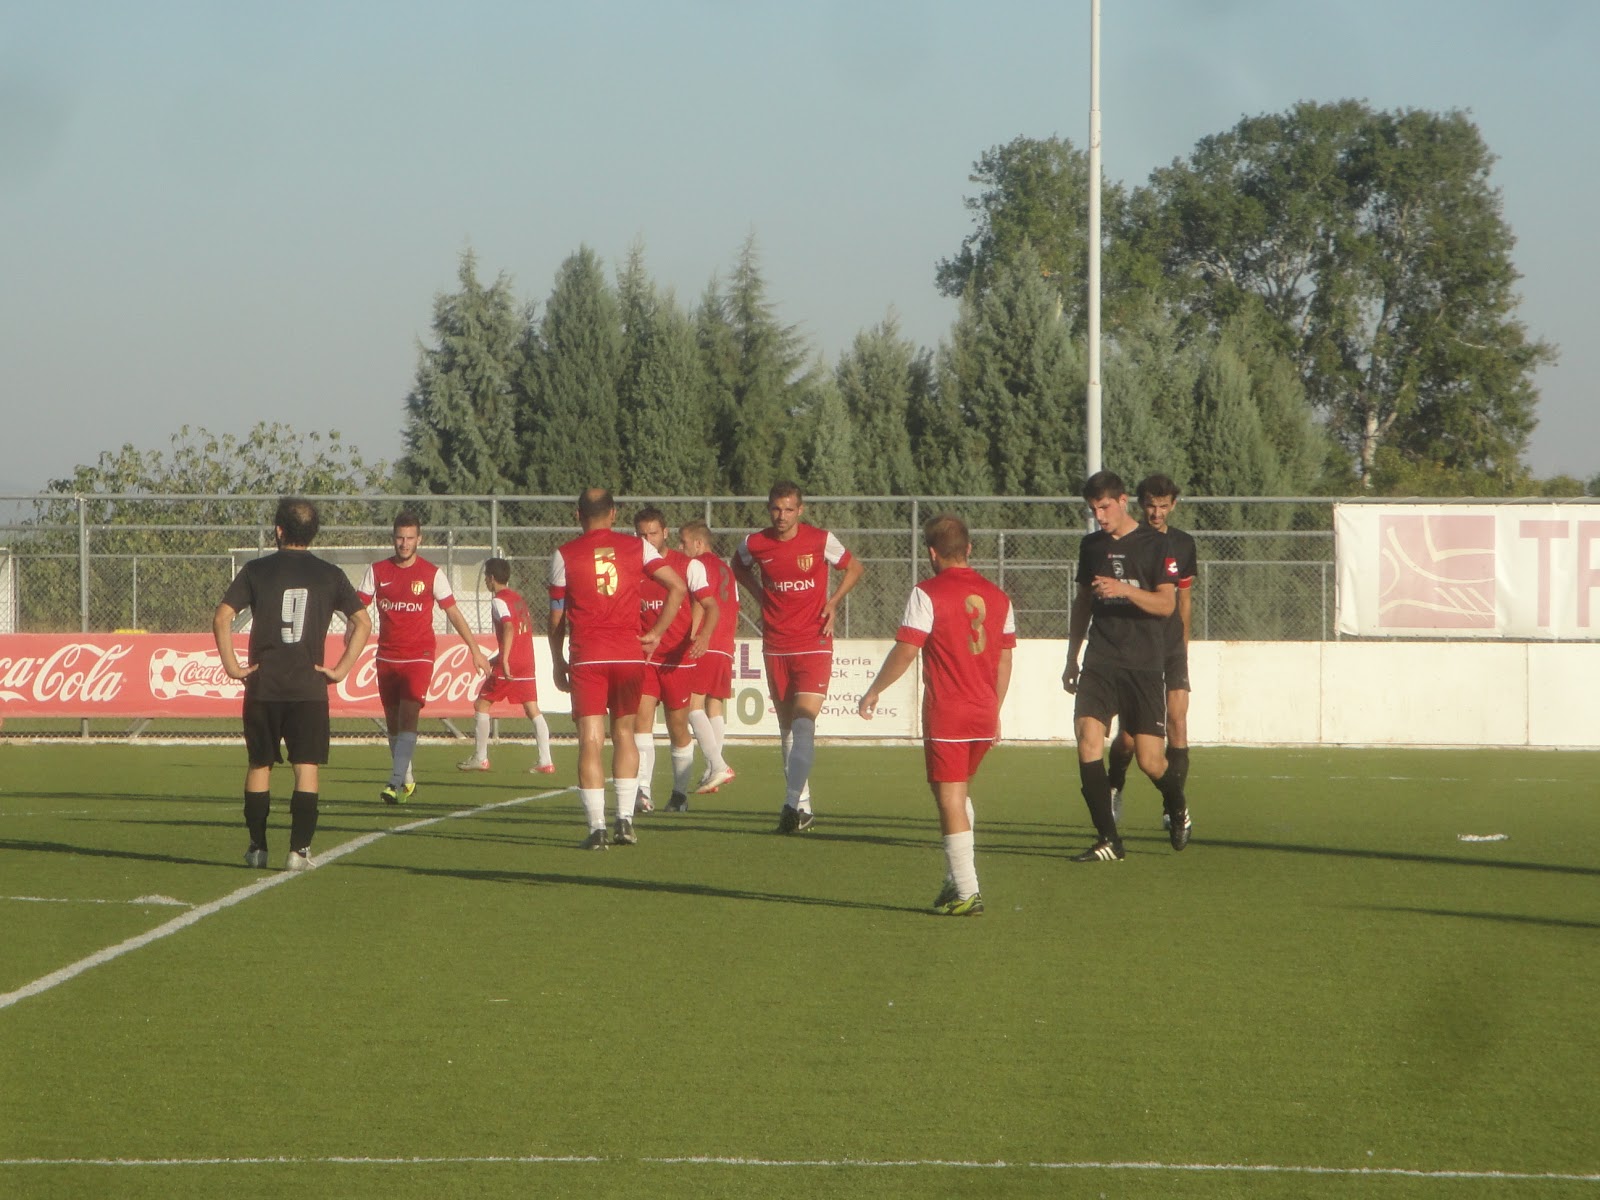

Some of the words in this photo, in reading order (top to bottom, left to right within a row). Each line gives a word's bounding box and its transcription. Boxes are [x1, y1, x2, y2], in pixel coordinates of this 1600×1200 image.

[594, 547, 618, 596] 5
[281, 588, 308, 643] 9
[965, 594, 987, 655] 3
[0, 643, 134, 702] ca-Cola
[179, 661, 249, 686] Coca-Co
[831, 656, 871, 665] teria
